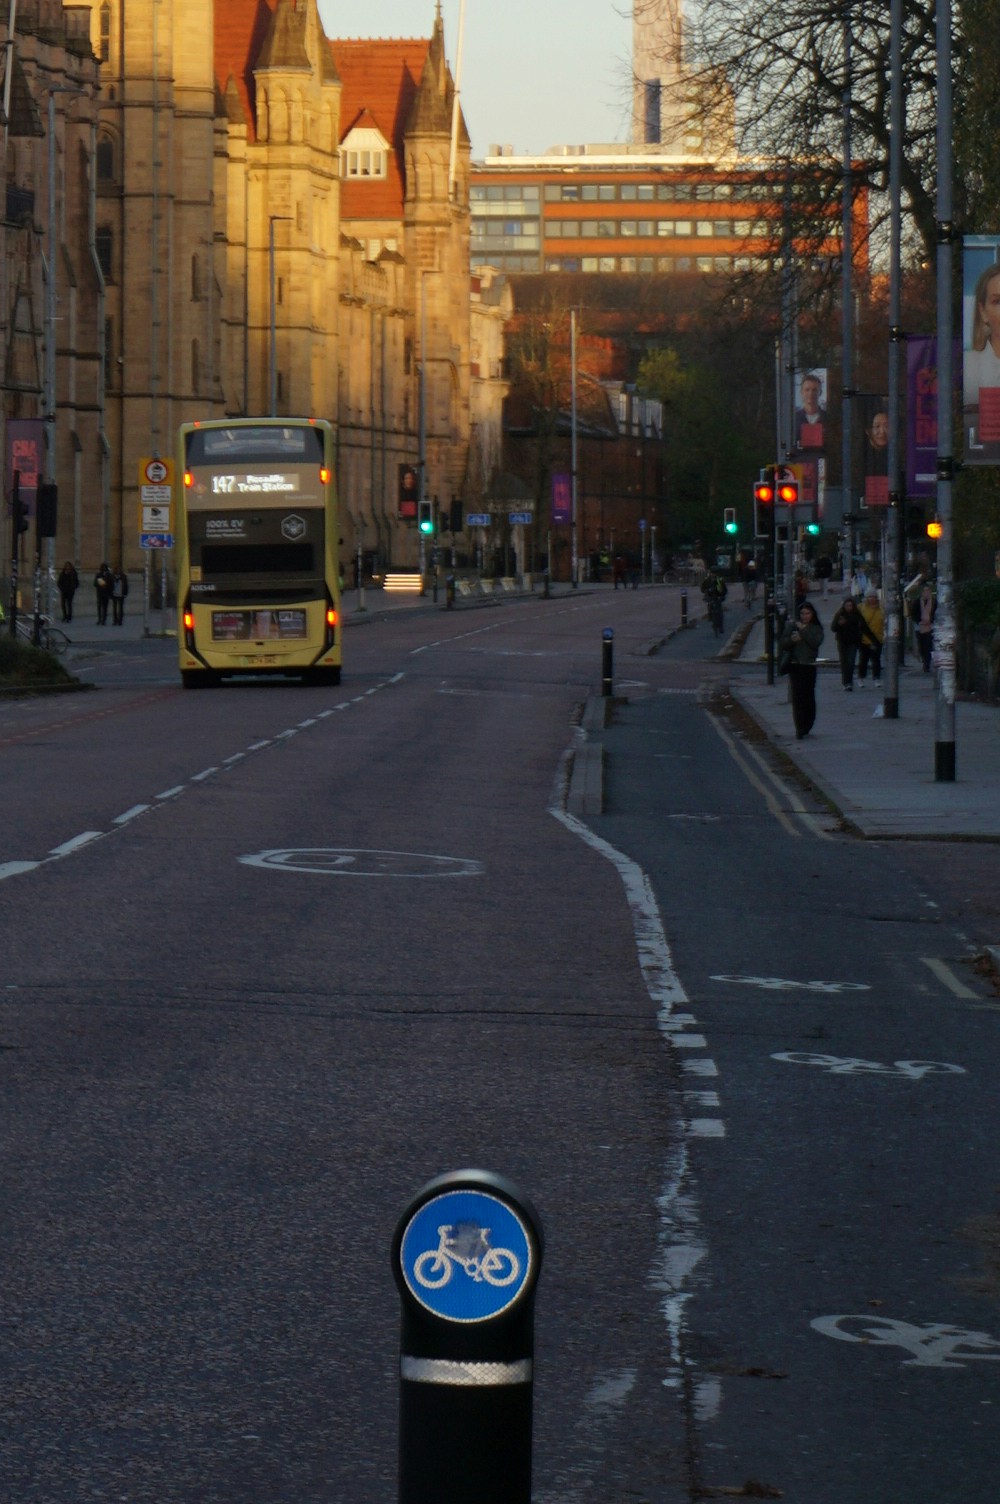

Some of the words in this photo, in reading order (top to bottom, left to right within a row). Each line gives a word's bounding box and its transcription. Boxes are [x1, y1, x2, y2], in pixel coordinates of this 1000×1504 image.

[212, 476, 235, 493] 147
[237, 482, 261, 492] Train
[262, 481, 294, 492] Station
[206, 519, 229, 528] 100%
